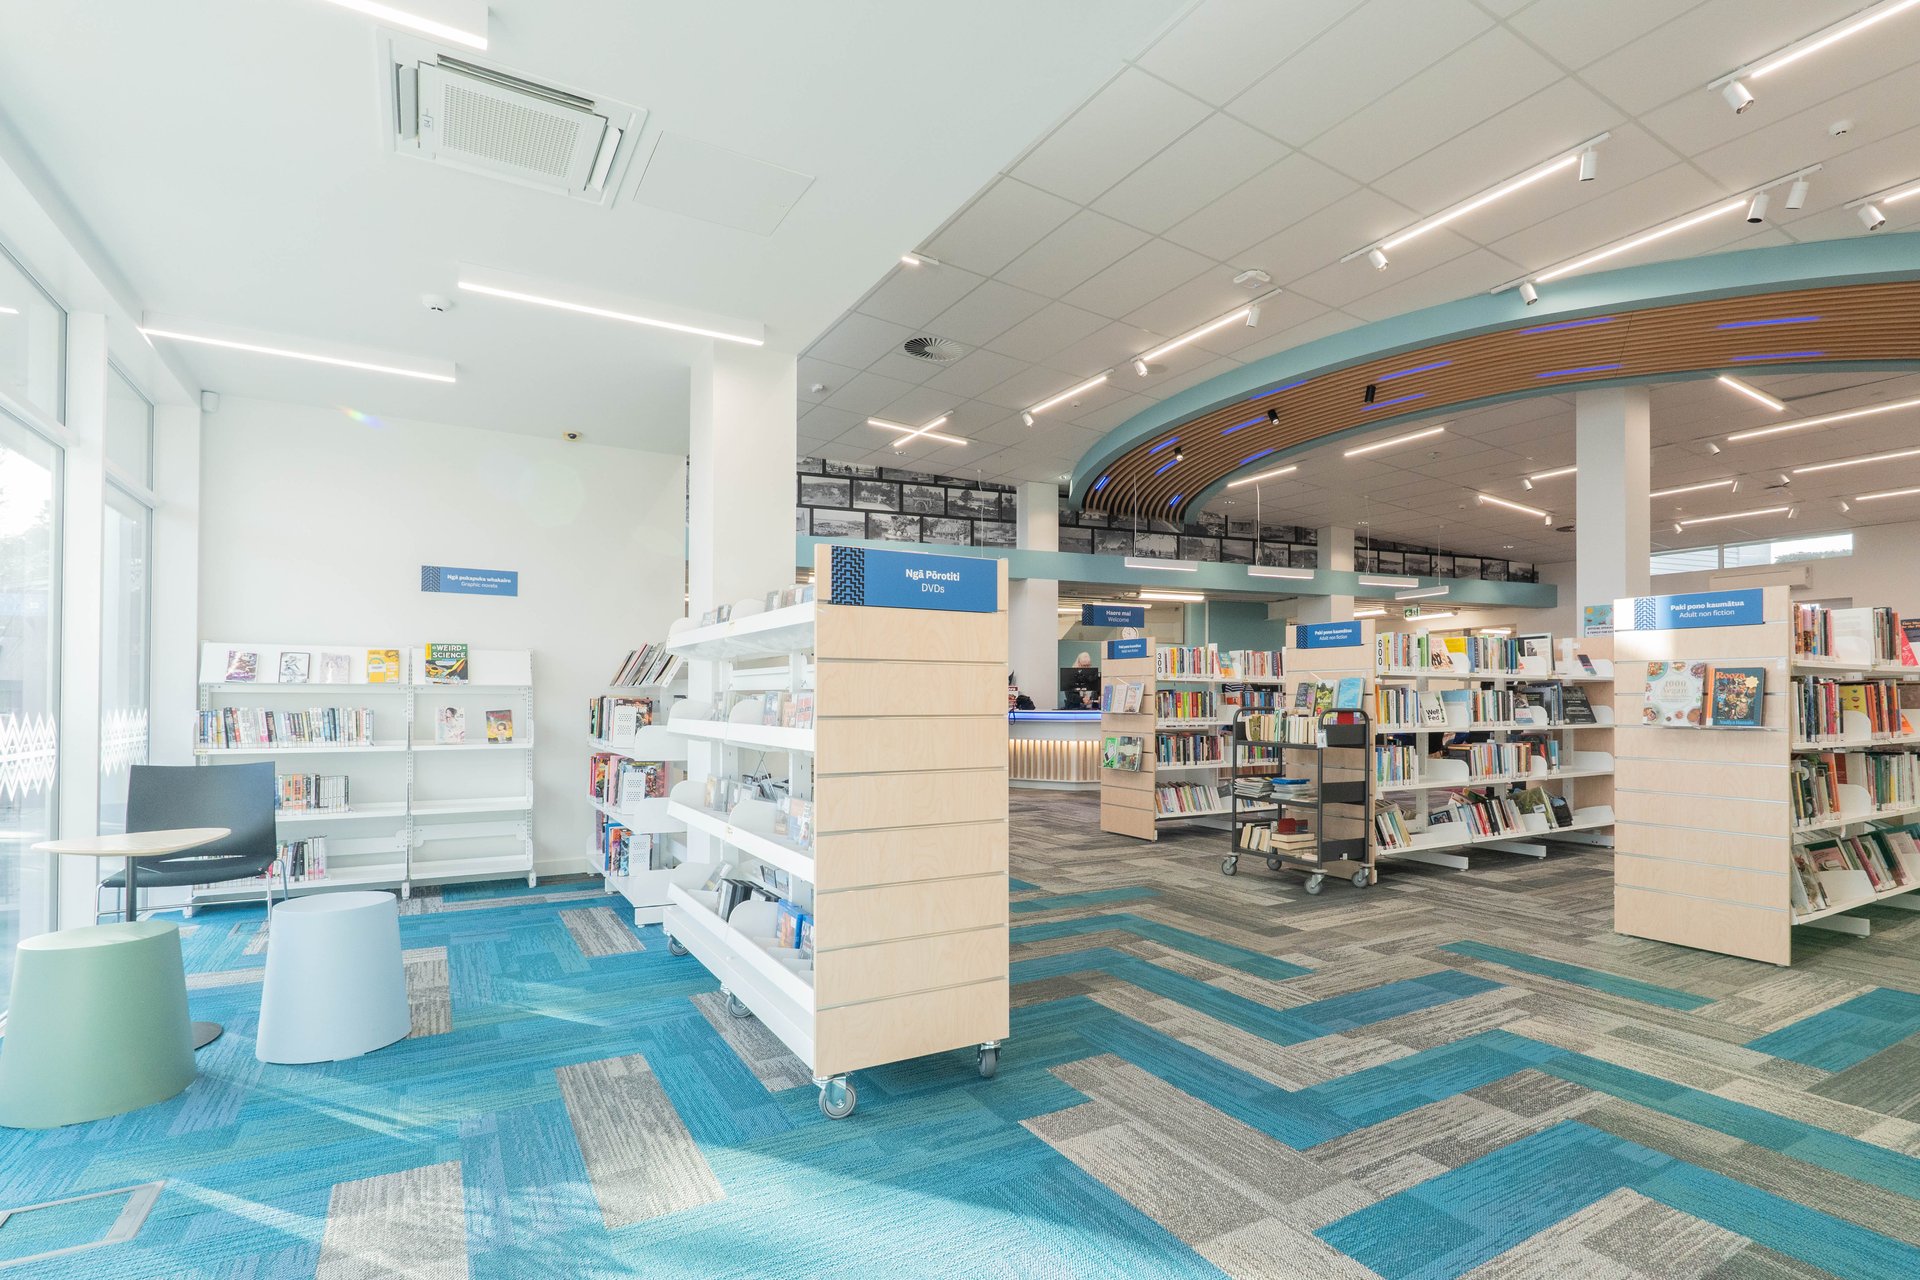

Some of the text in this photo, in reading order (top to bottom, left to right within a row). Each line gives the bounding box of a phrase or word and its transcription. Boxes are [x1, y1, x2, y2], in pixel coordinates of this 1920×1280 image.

[905, 568, 960, 582] Ngā Pōrotiti
[921, 583, 945, 593] DVDs
[1670, 603, 1686, 611] Paki
[1706, 600, 1745, 608] kaumātua
